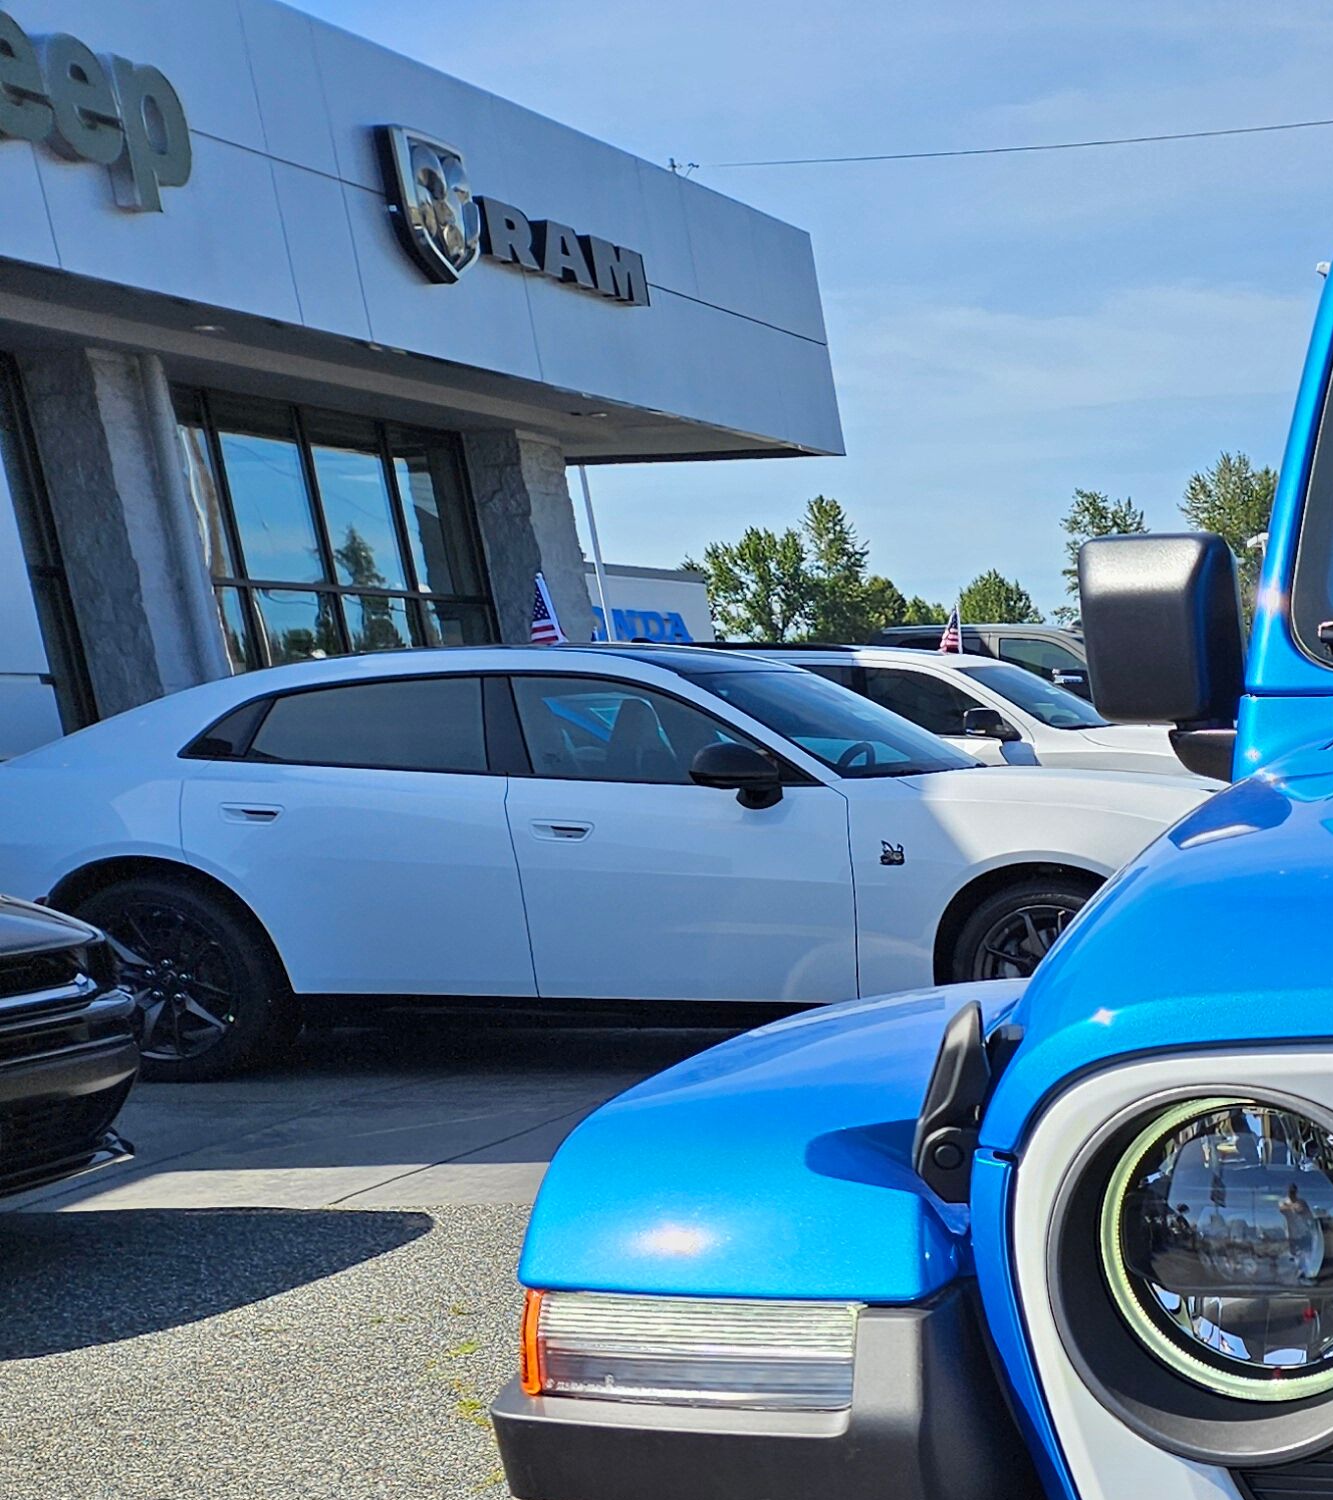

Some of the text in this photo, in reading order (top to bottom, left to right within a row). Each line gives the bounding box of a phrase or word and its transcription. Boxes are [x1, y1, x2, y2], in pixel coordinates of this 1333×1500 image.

[0, 9, 192, 213] eep
[474, 195, 650, 306] RAM
[591, 606, 694, 643] ONDA
